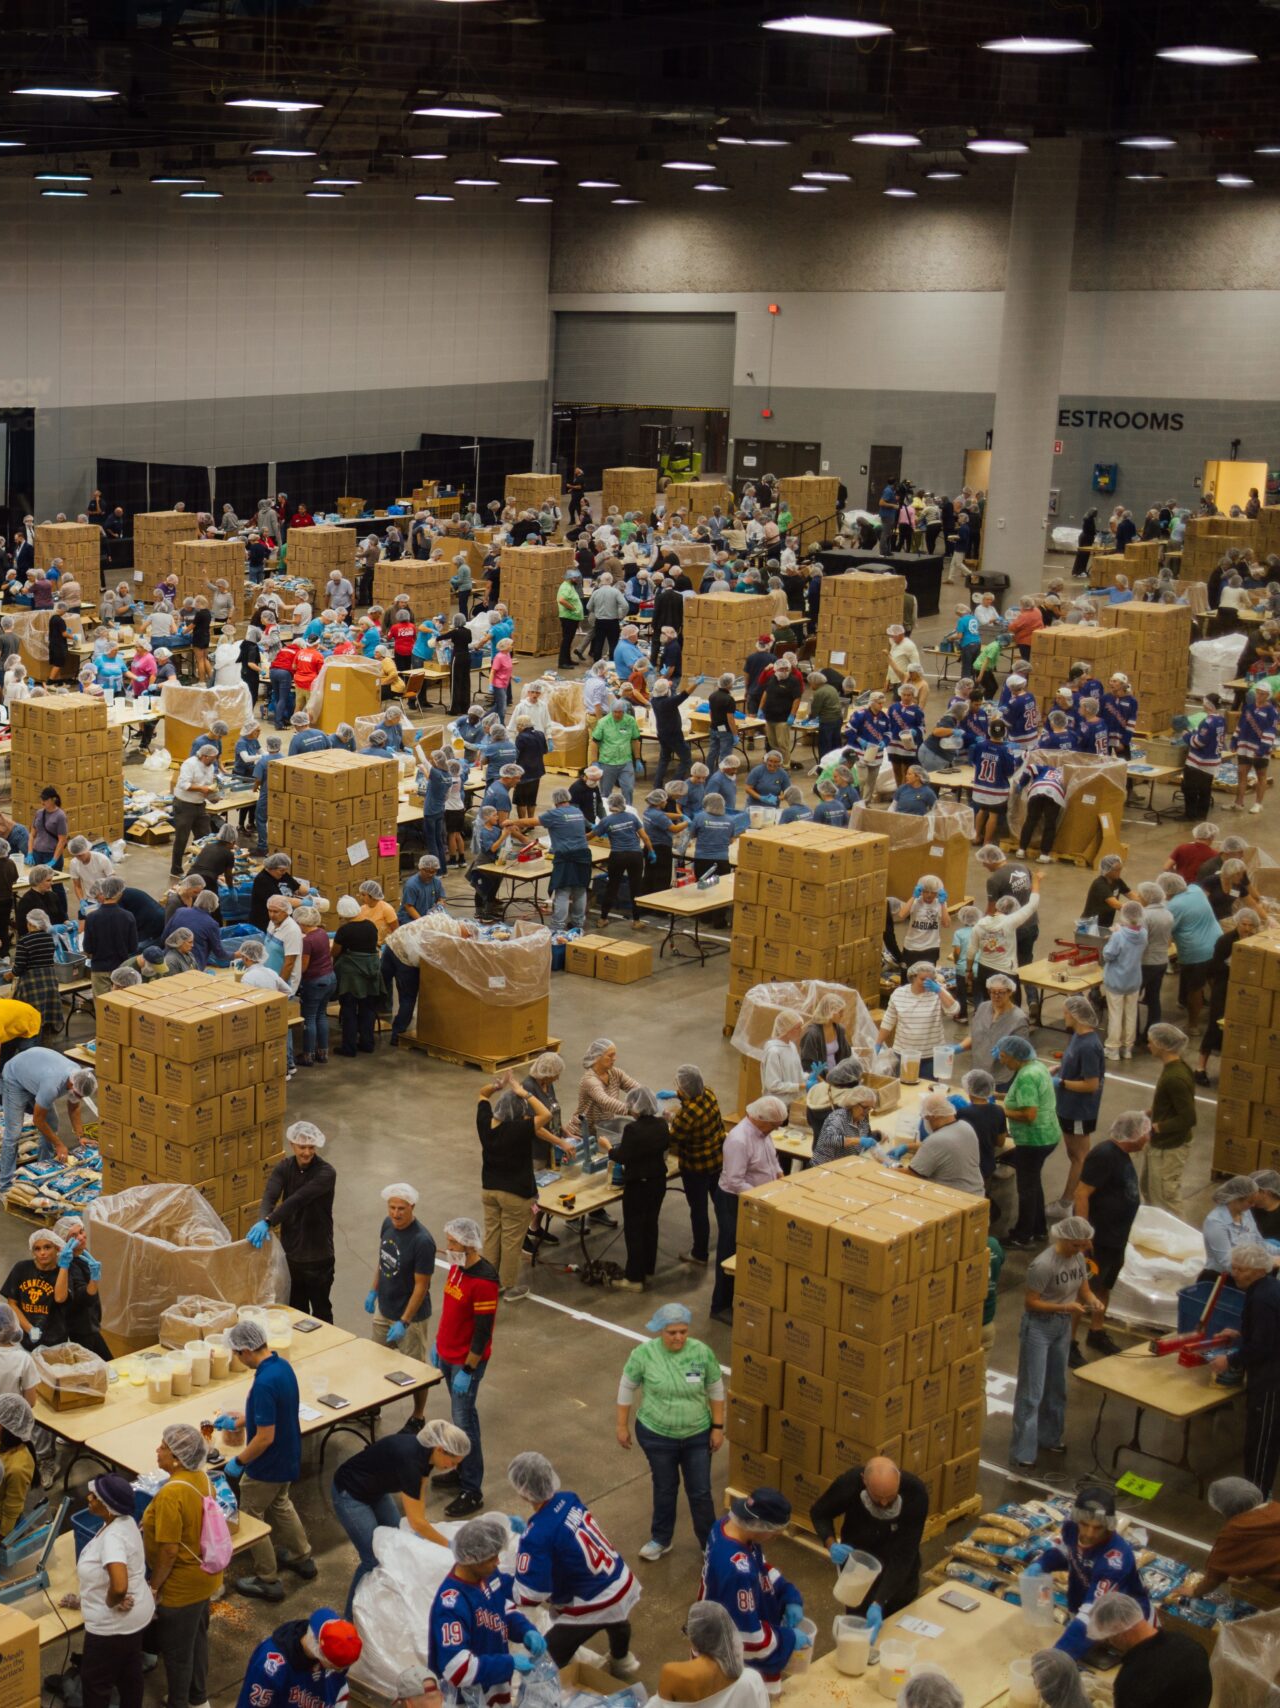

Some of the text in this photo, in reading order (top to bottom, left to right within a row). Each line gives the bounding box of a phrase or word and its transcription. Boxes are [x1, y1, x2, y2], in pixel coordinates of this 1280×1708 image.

[1058, 409, 1184, 431] ESTROOMS
[978, 760, 997, 782] 11
[1056, 1269, 1084, 1285] IOWA
[19, 1279, 54, 1296] TENNESSEE
[22, 1302, 49, 1315] ASEBALL
[442, 1621, 463, 1646] 19
[3, 1649, 25, 1662] Meals
[250, 1683, 273, 1708] 25
